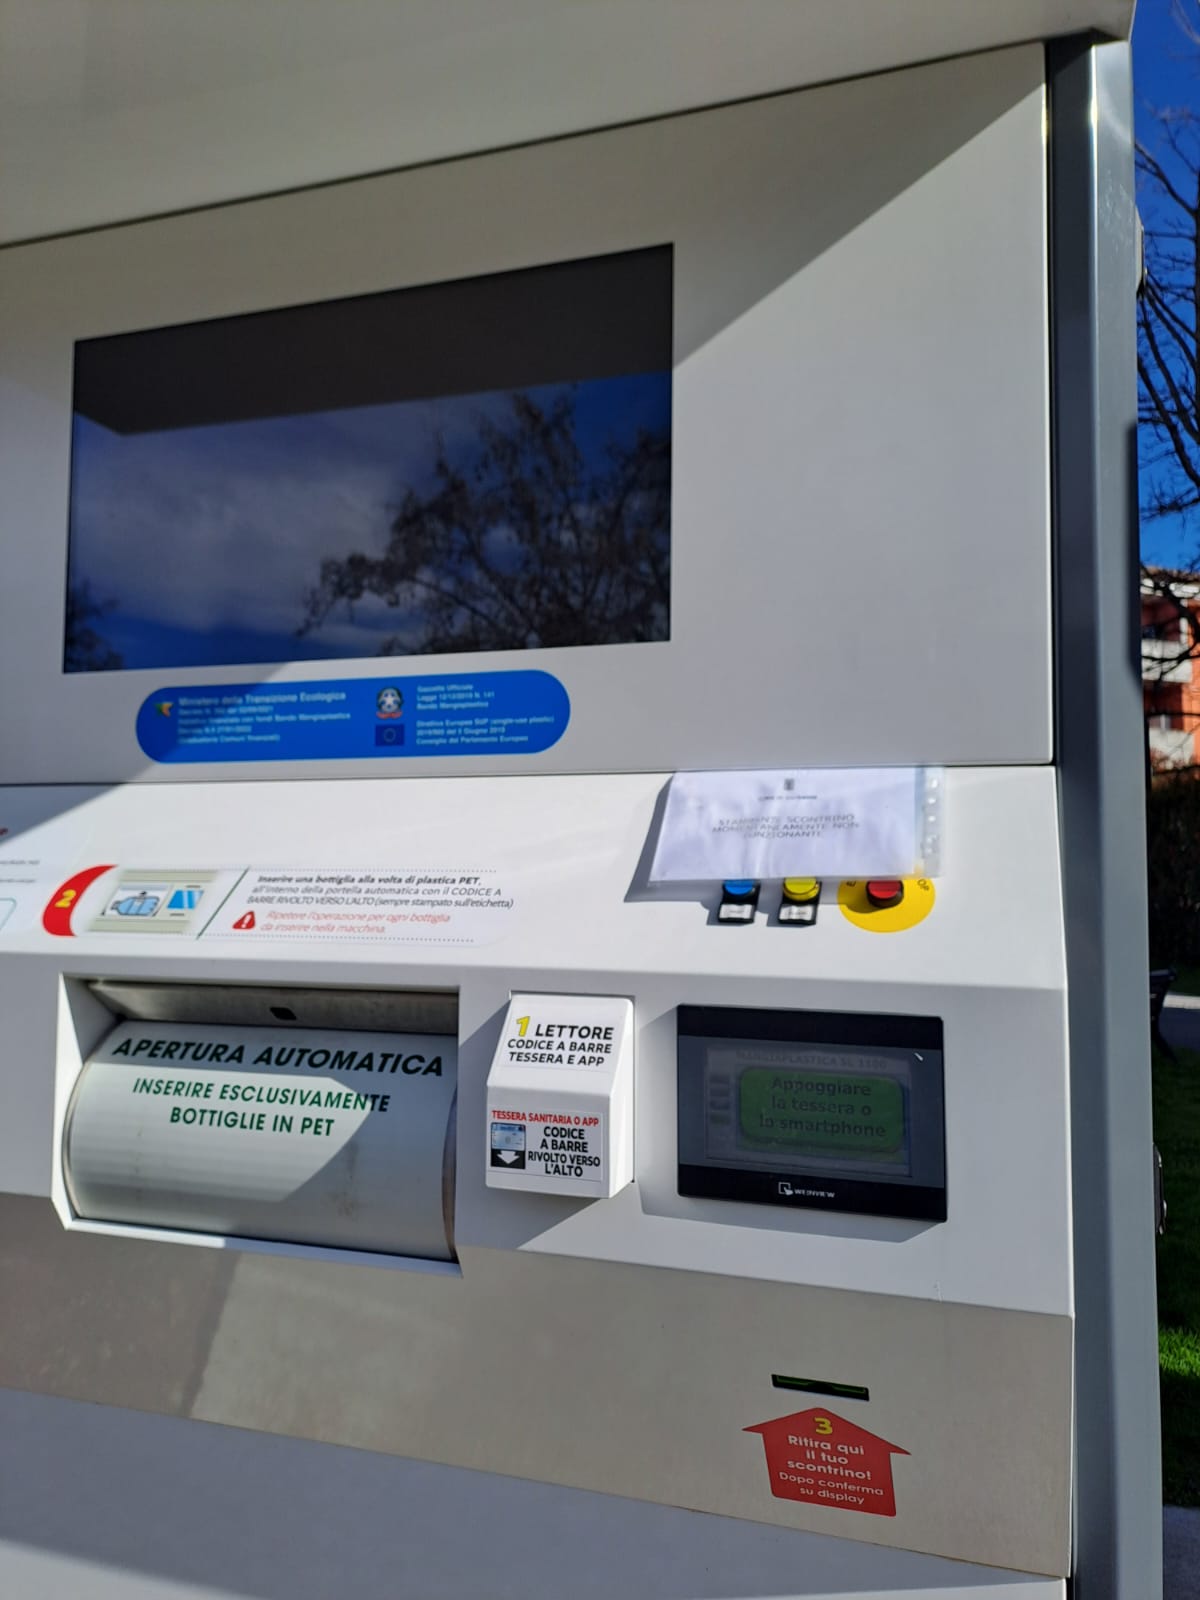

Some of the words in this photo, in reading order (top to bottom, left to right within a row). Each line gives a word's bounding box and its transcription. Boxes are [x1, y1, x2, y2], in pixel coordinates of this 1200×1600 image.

[245, 693, 298, 704] Transizione
[300, 691, 346, 704] Ecologica
[258, 876, 293, 884] Inserire
[295, 876, 313, 884] una
[316, 875, 355, 885] bottiglia
[358, 876, 375, 884] alla
[378, 876, 402, 885] volta
[404, 876, 416, 885] di
[416, 876, 456, 886] plastica
[458, 876, 482, 886] PET,
[55, 889, 77, 909] 2
[252, 885, 300, 894] all'interno
[301, 886, 324, 895] della
[324, 886, 362, 896] portella
[364, 886, 419, 896] automatica
[422, 888, 440, 896] con
[442, 886, 450, 896] il
[451, 888, 493, 897] CODICE
[493, 888, 502, 897] A
[246, 896, 275, 905] BARRE
[275, 896, 314, 905] RIVOLTO
[315, 896, 345, 906] VERSO
[374, 897, 410, 908] (sempre
[411, 898, 453, 909] stampato
[454, 899, 514, 910] sull'etichetta)
[410, 913, 450, 925] bottiglia
[516, 1016, 530, 1038] 1
[535, 1024, 614, 1040] LETTORE
[508, 1038, 554, 1050] CODICE
[556, 1041, 566, 1052] A
[569, 1042, 612, 1054] BARRE
[112, 1038, 244, 1064] APERTURA
[253, 1046, 443, 1077] AUTOMATICA
[508, 1052, 564, 1064] TESSERA
[567, 1054, 575, 1065] E
[578, 1056, 604, 1066] APP
[132, 1077, 215, 1100] INSERIRE
[219, 1084, 390, 1112] ESCLUSIVAMENTE
[771, 1076, 872, 1096] Appoggiare
[772, 1096, 786, 1110] la
[791, 1097, 855, 1116] tessera
[861, 1104, 872, 1116] o
[169, 1106, 266, 1131] BOTTIGLIE
[272, 1114, 294, 1132] IN
[299, 1116, 334, 1136] PET
[492, 1110, 526, 1121] TESSERA
[528, 1112, 572, 1125] SANITARIA
[574, 1117, 581, 1126] O
[582, 1117, 599, 1127] APP
[759, 1114, 774, 1128] lo
[780, 1118, 887, 1137] smartphone
[543, 1126, 585, 1140] CODICE
[540, 1138, 548, 1150] A
[551, 1140, 588, 1152] BARRE
[528, 1150, 568, 1164] RIVOLTO
[569, 1154, 600, 1167] VERSO
[544, 1162, 584, 1177] L'ALTO
[814, 1417, 833, 1434] 3
[788, 1434, 831, 1450] Ritira
[837, 1444, 864, 1456] qui
[806, 1450, 815, 1460] il
[820, 1452, 848, 1465] tuo
[787, 1460, 872, 1480] scontrino!
[778, 1471, 814, 1485] Dopo
[818, 1479, 884, 1496] conferma
[800, 1487, 814, 1496] su
[818, 1488, 865, 1505] display
